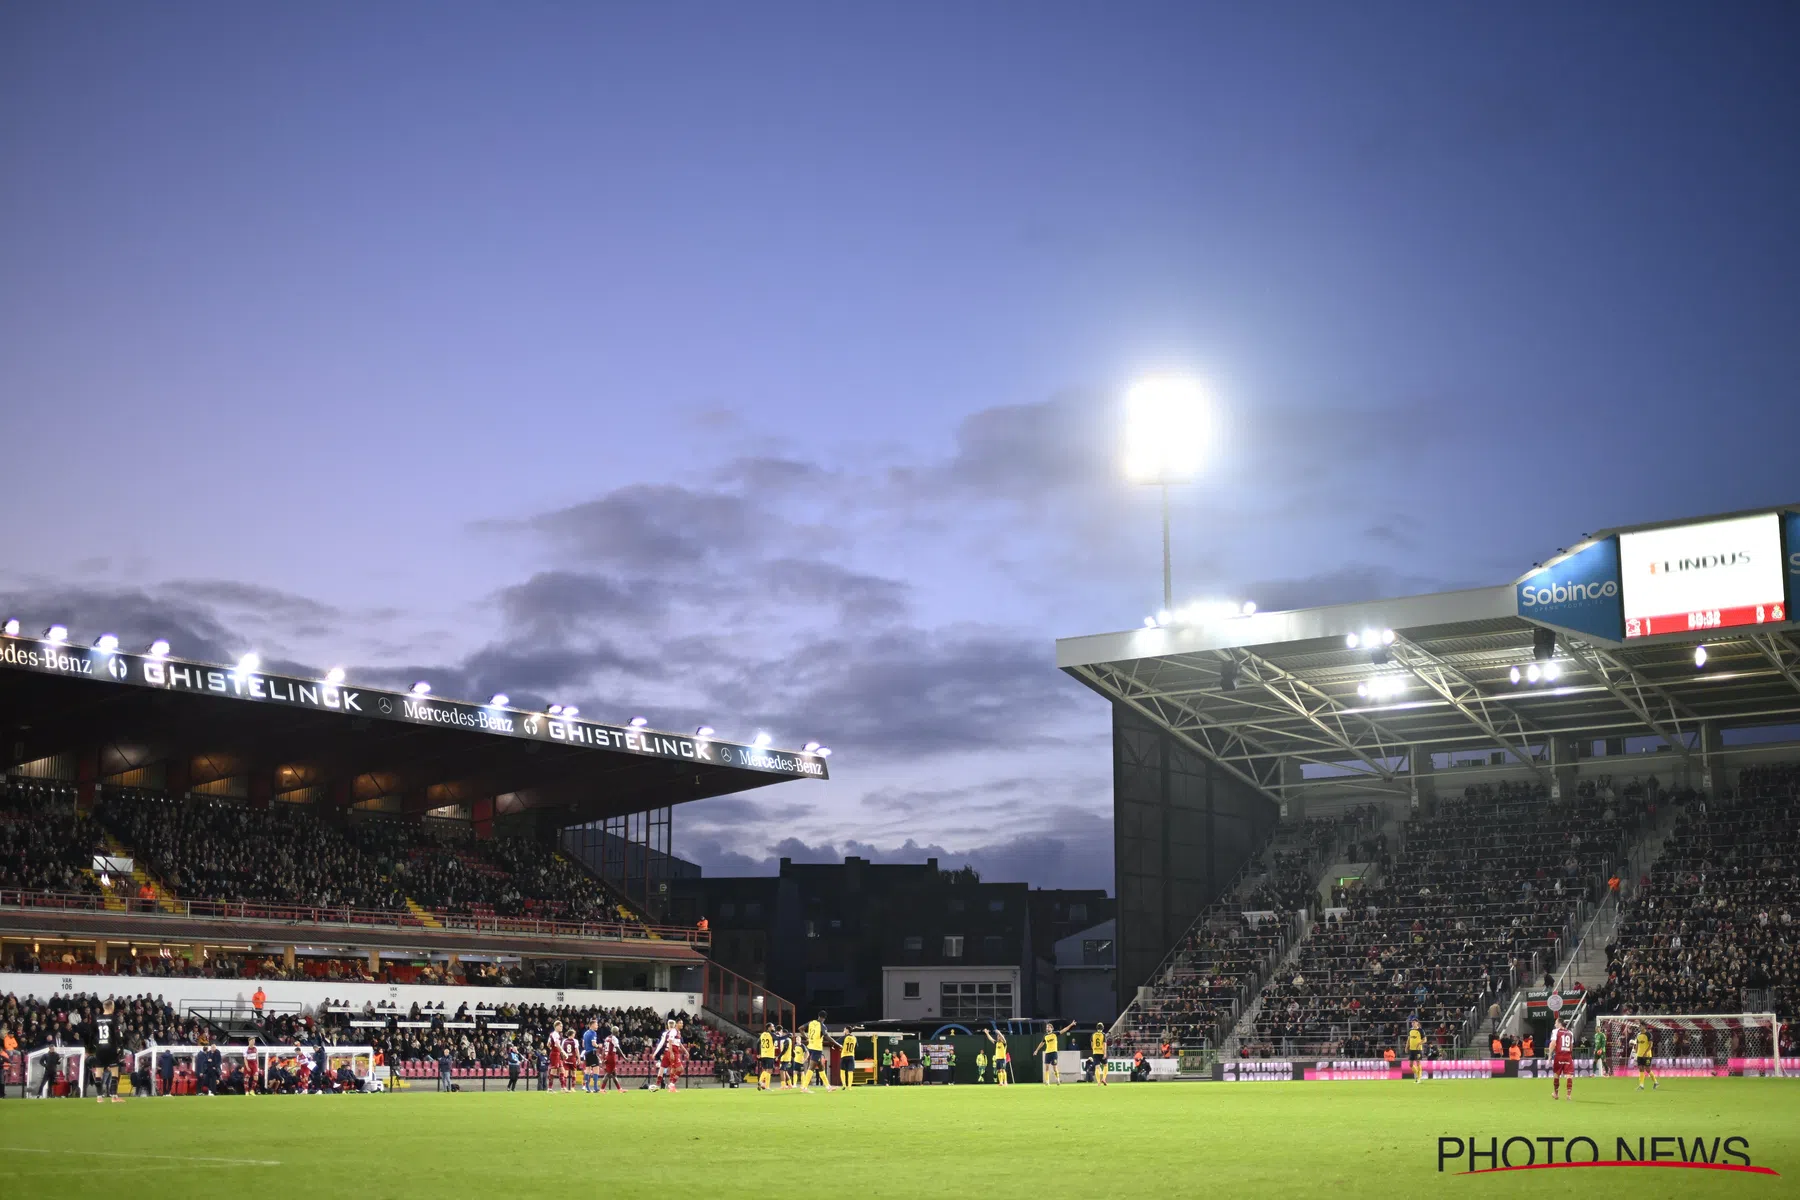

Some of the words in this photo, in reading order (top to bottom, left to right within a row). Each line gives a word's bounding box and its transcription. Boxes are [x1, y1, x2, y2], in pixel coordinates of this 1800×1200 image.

[1522, 580, 1618, 607] Sobinco
[143, 662, 363, 711] GHISTELINCK
[403, 700, 514, 732] Mercedes-Benz
[548, 721, 711, 760] GHISTELINCK
[739, 750, 823, 775] Mercedes-Benz
[98, 1025, 109, 1039] 13
[761, 1038, 770, 1049] 23
[846, 1042, 855, 1053] 10
[1095, 1038, 1101, 1047] 6
[1561, 1034, 1570, 1047] 19
[566, 1043, 572, 1053] 8
